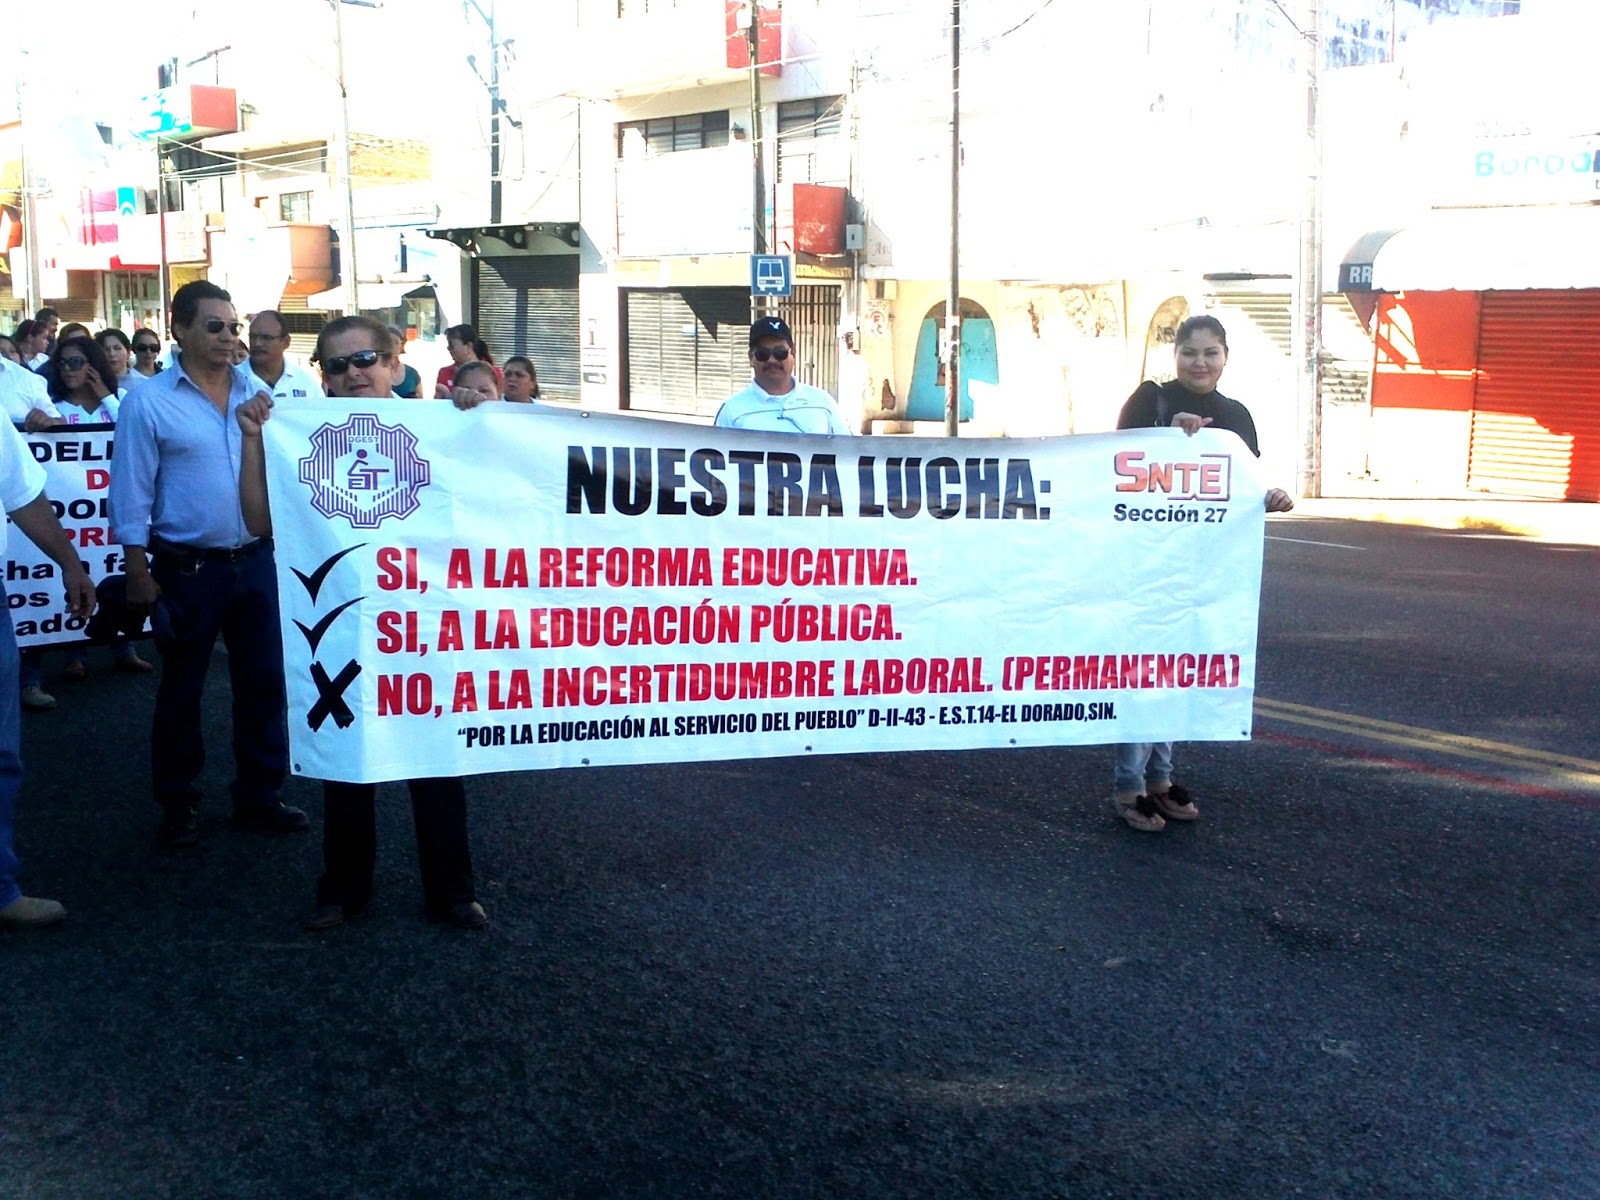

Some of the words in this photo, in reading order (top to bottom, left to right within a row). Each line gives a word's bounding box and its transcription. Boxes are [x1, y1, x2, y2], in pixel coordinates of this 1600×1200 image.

[565, 445, 844, 517] NUESTRA
[857, 455, 1051, 520] LUCHA:
[1113, 503, 1199, 523] Sección
[1204, 507, 1227, 523] 27
[377, 547, 427, 593] SI,
[447, 549, 473, 589] A
[483, 548, 529, 589] LA
[539, 547, 713, 588] REFORMA
[722, 547, 918, 587] EDUCATIVA.
[378, 611, 428, 655] SI,
[438, 610, 464, 652] A
[474, 609, 519, 651] LA
[530, 599, 741, 649] EDUCACIÓN
[750, 598, 902, 643] PÚBLICA.
[378, 673, 442, 716] NO,
[452, 671, 477, 713] A
[488, 669, 533, 711] LA
[543, 660, 835, 708] INCERTIDUMBRE
[844, 657, 993, 697] LABORAL.
[1002, 654, 1240, 691] (PERMANENCIA)
[510, 723, 534, 745] LA
[537, 714, 646, 744] EDUCACIÓN
[648, 716, 671, 738] AL
[674, 712, 757, 737] SERVICIO
[761, 712, 791, 732] DEL
